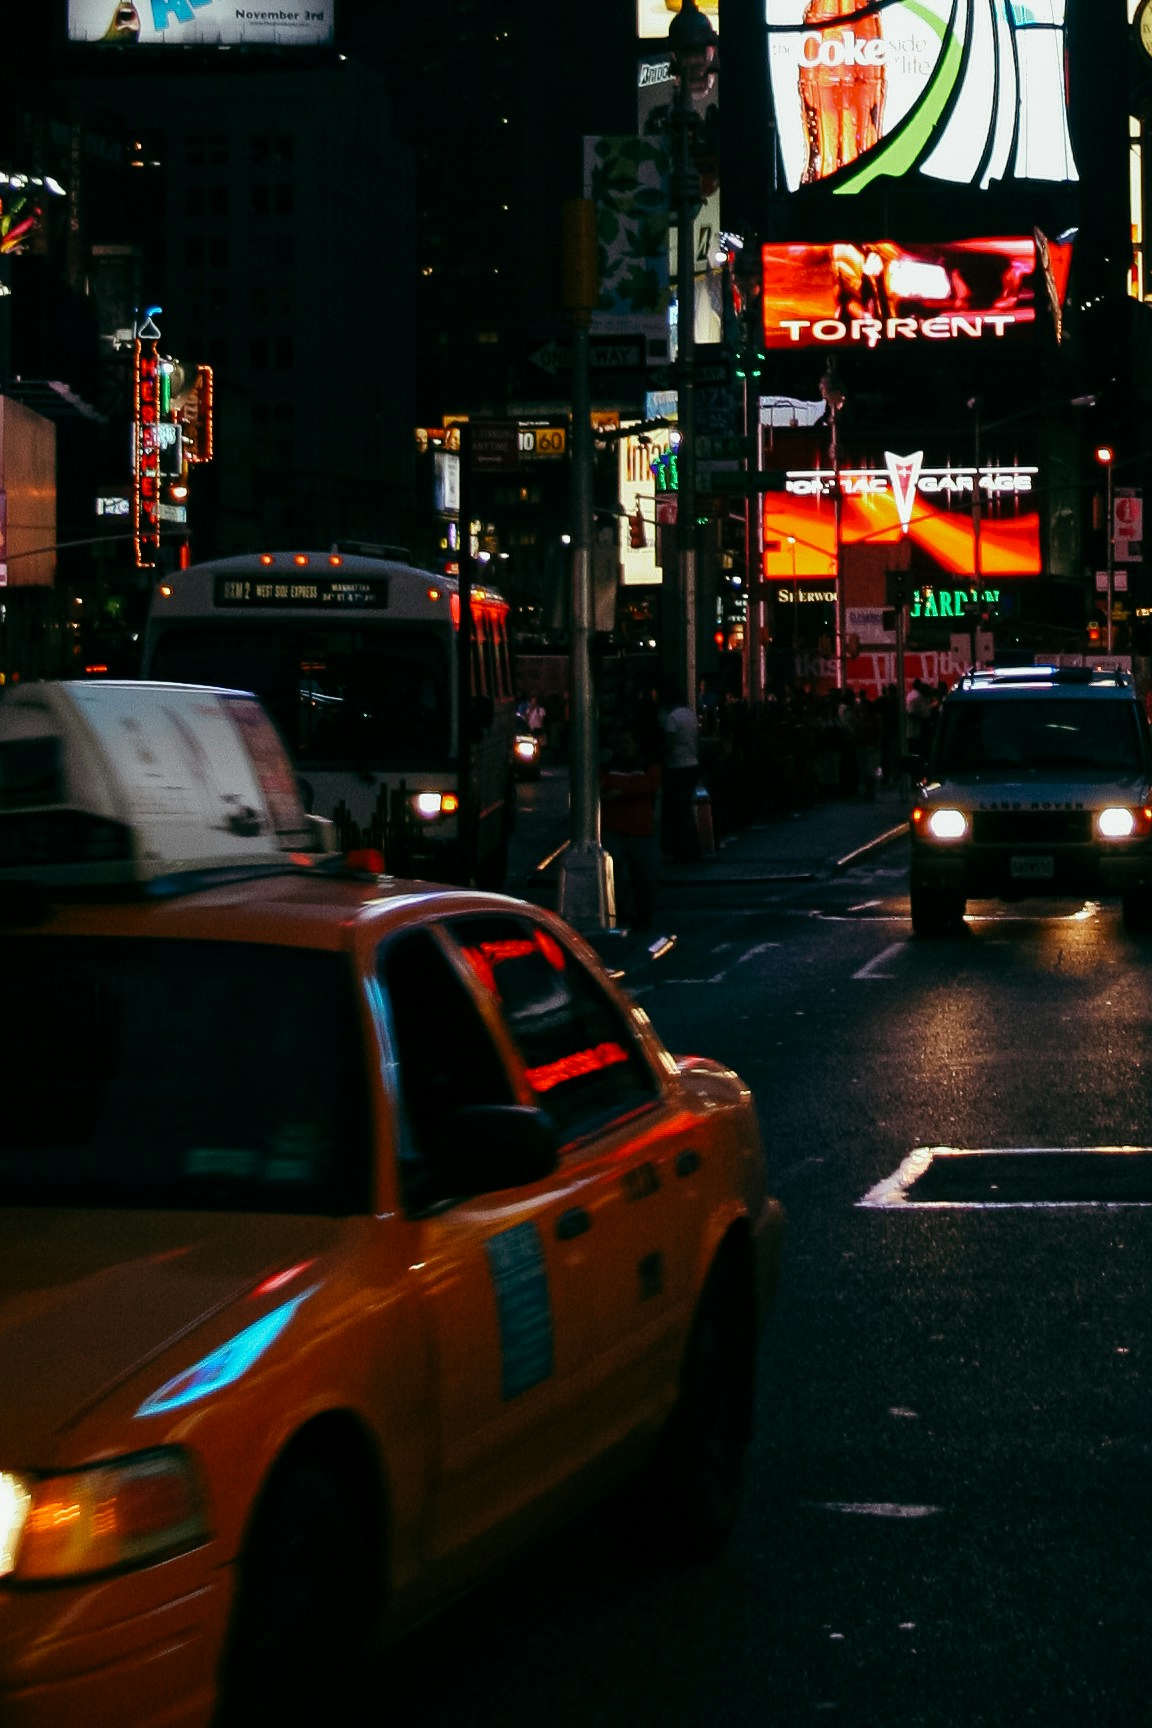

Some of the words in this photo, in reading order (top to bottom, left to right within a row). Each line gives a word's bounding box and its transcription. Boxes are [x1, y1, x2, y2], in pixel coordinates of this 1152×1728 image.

[235, 9, 300, 21] November
[305, 10, 325, 21] 3rd
[799, 30, 886, 67] Coke
[779, 315, 1016, 347] TORRENT
[595, 346, 630, 364] WAY
